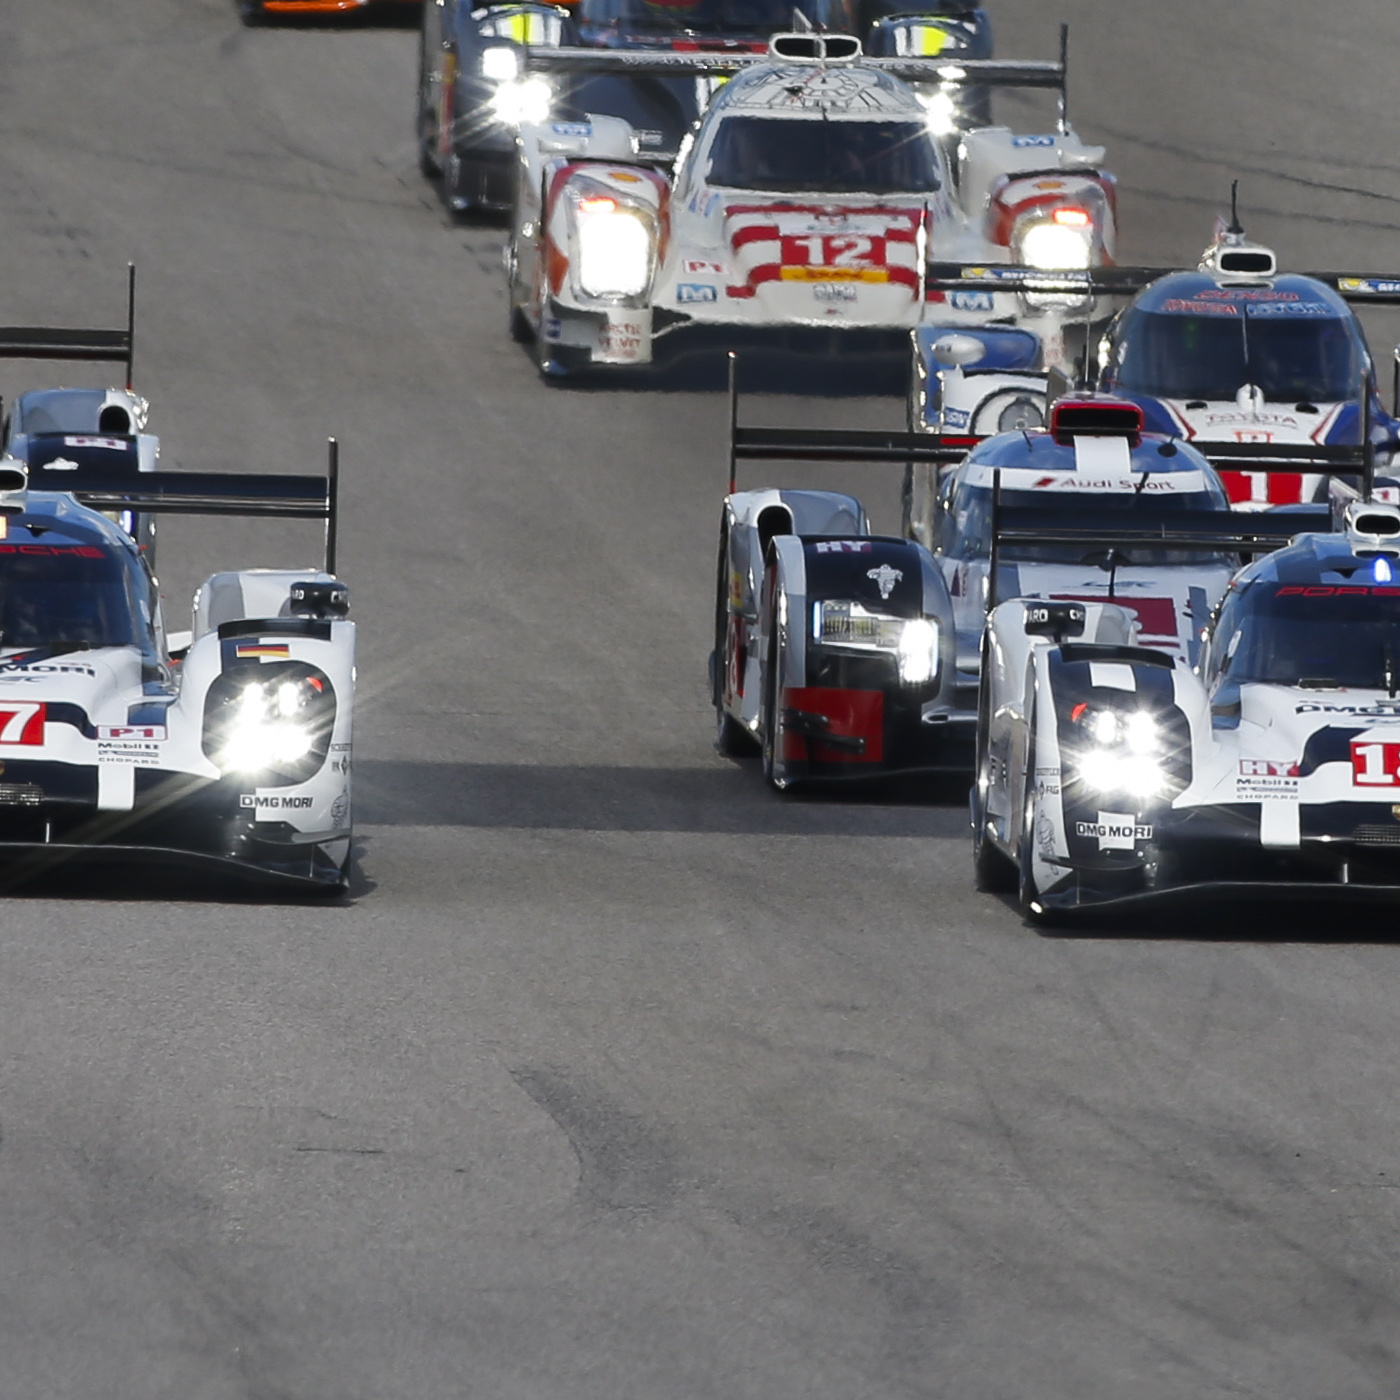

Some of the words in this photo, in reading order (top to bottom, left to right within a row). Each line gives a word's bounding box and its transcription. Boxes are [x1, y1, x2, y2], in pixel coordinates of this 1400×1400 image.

[795, 236, 874, 266] 12
[1060, 477, 1112, 488] Audi
[1119, 479, 1176, 491] Sport
[1240, 471, 1268, 504] 1
[816, 541, 870, 554] HY
[8, 663, 97, 678] MORI
[1295, 704, 1386, 715] DMG
[110, 728, 154, 738] P1
[98, 742, 141, 750] Mobil
[98, 757, 160, 765] CHOPARD
[1241, 761, 1298, 777] HY
[241, 796, 280, 808] DMG
[281, 796, 314, 809] MORI
[1076, 823, 1107, 837] DMG
[1108, 825, 1152, 838] MORI
